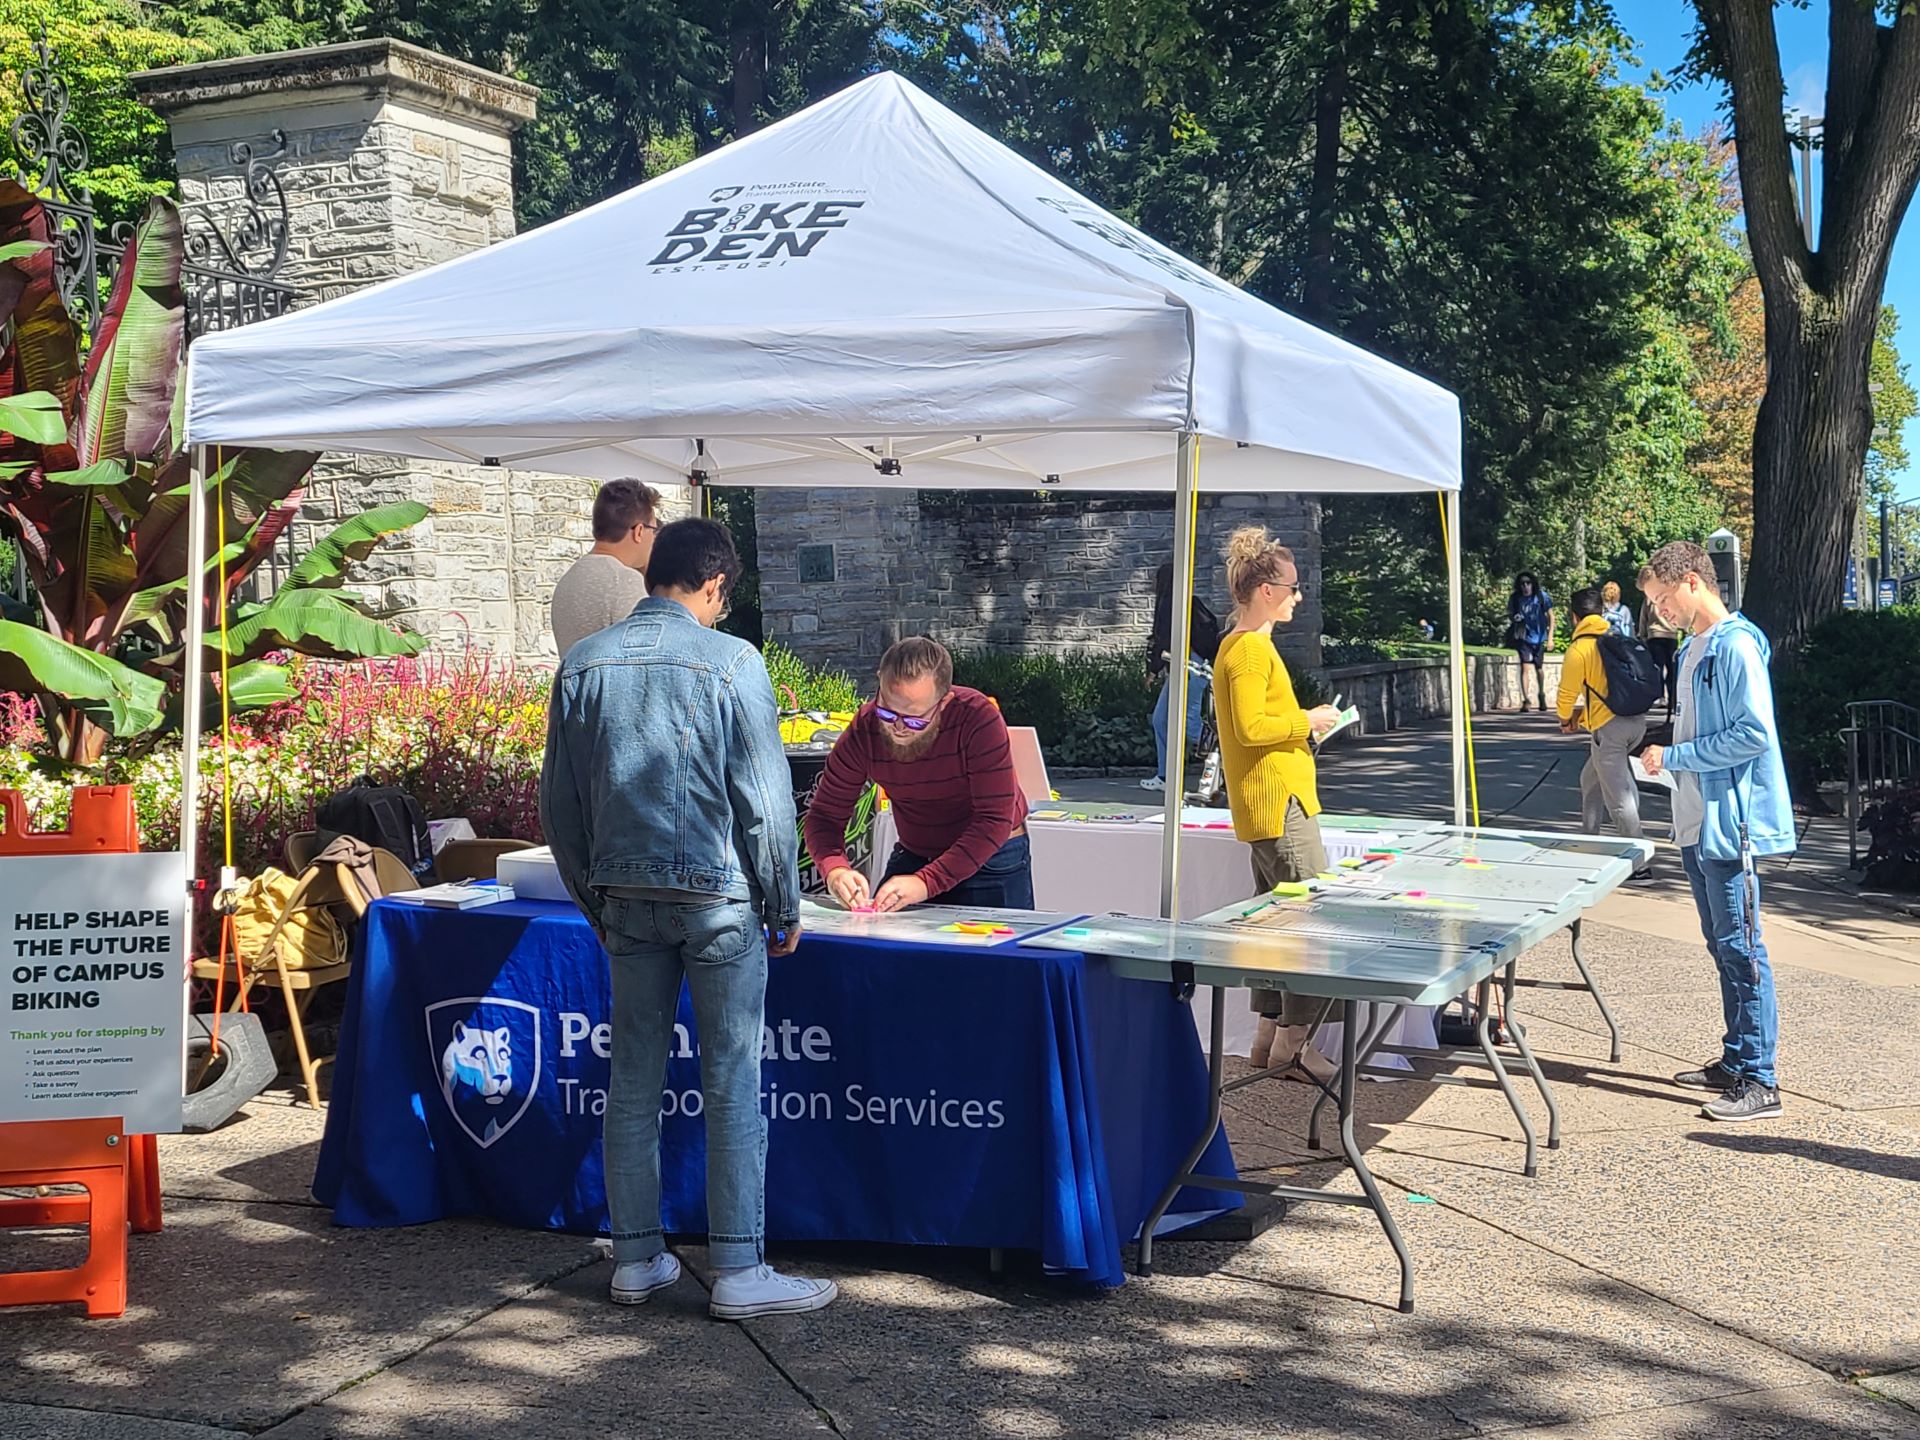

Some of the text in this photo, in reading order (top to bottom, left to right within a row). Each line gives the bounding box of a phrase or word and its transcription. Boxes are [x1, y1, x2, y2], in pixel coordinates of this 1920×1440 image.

[750, 181, 826, 191] PennState
[646, 230, 829, 266] DEN
[650, 260, 788, 275] EST. 2021
[14, 910, 169, 931] HELP SHAPE
[13, 936, 170, 957] THE FUTURE
[12, 962, 164, 984] OF CAMPUS
[11, 990, 100, 1011] BIKING
[10, 1025, 165, 1041] Thank you for stopping by
[76, 1058, 92, 1066] your
[93, 1056, 133, 1064] experiences
[47, 1069, 80, 1077] questions
[95, 1089, 138, 1097] engagement
[845, 1084, 1006, 1129] Services
